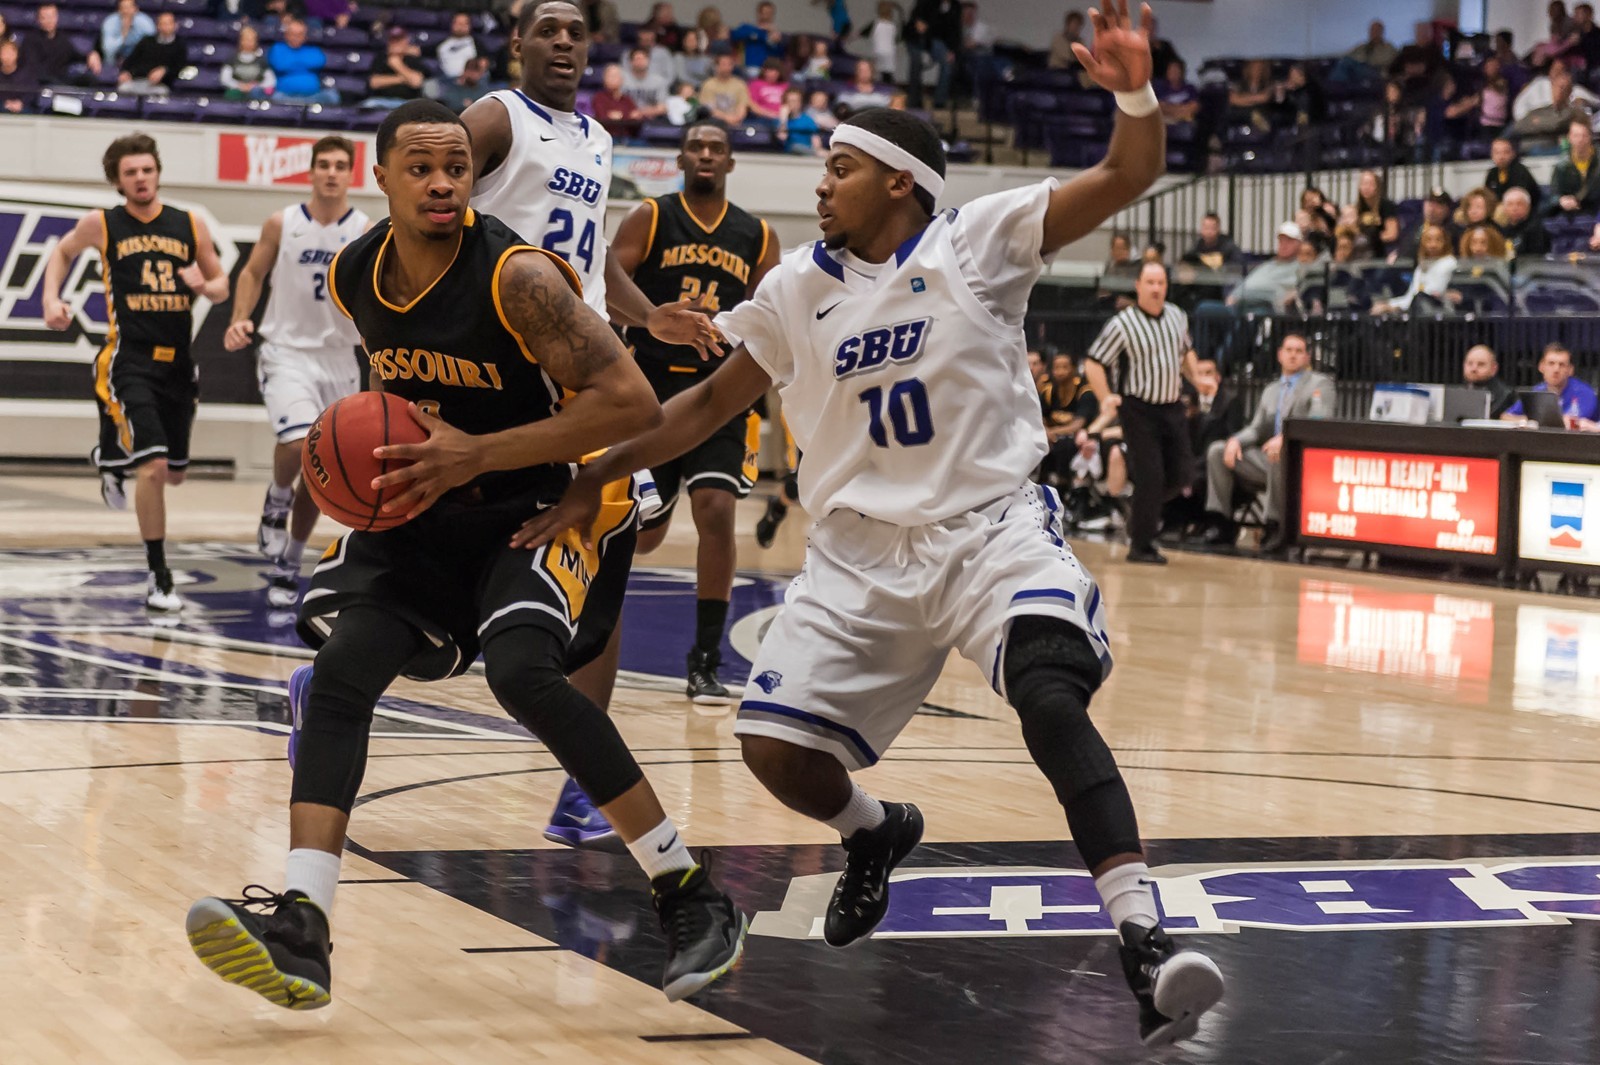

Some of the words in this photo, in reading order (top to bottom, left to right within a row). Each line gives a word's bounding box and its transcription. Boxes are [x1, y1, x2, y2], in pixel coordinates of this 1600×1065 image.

[544, 165, 603, 209] SBU
[116, 234, 189, 261] MISSOURI
[541, 207, 596, 275] 24
[141, 260, 176, 292] 42
[660, 243, 750, 286] MISSOURI
[126, 294, 191, 312] WESTERN
[369, 347, 503, 390] ISSOURI
[833, 316, 934, 382] SBU
[858, 377, 935, 449] 10
[1353, 485, 1428, 519] MATERIALS
